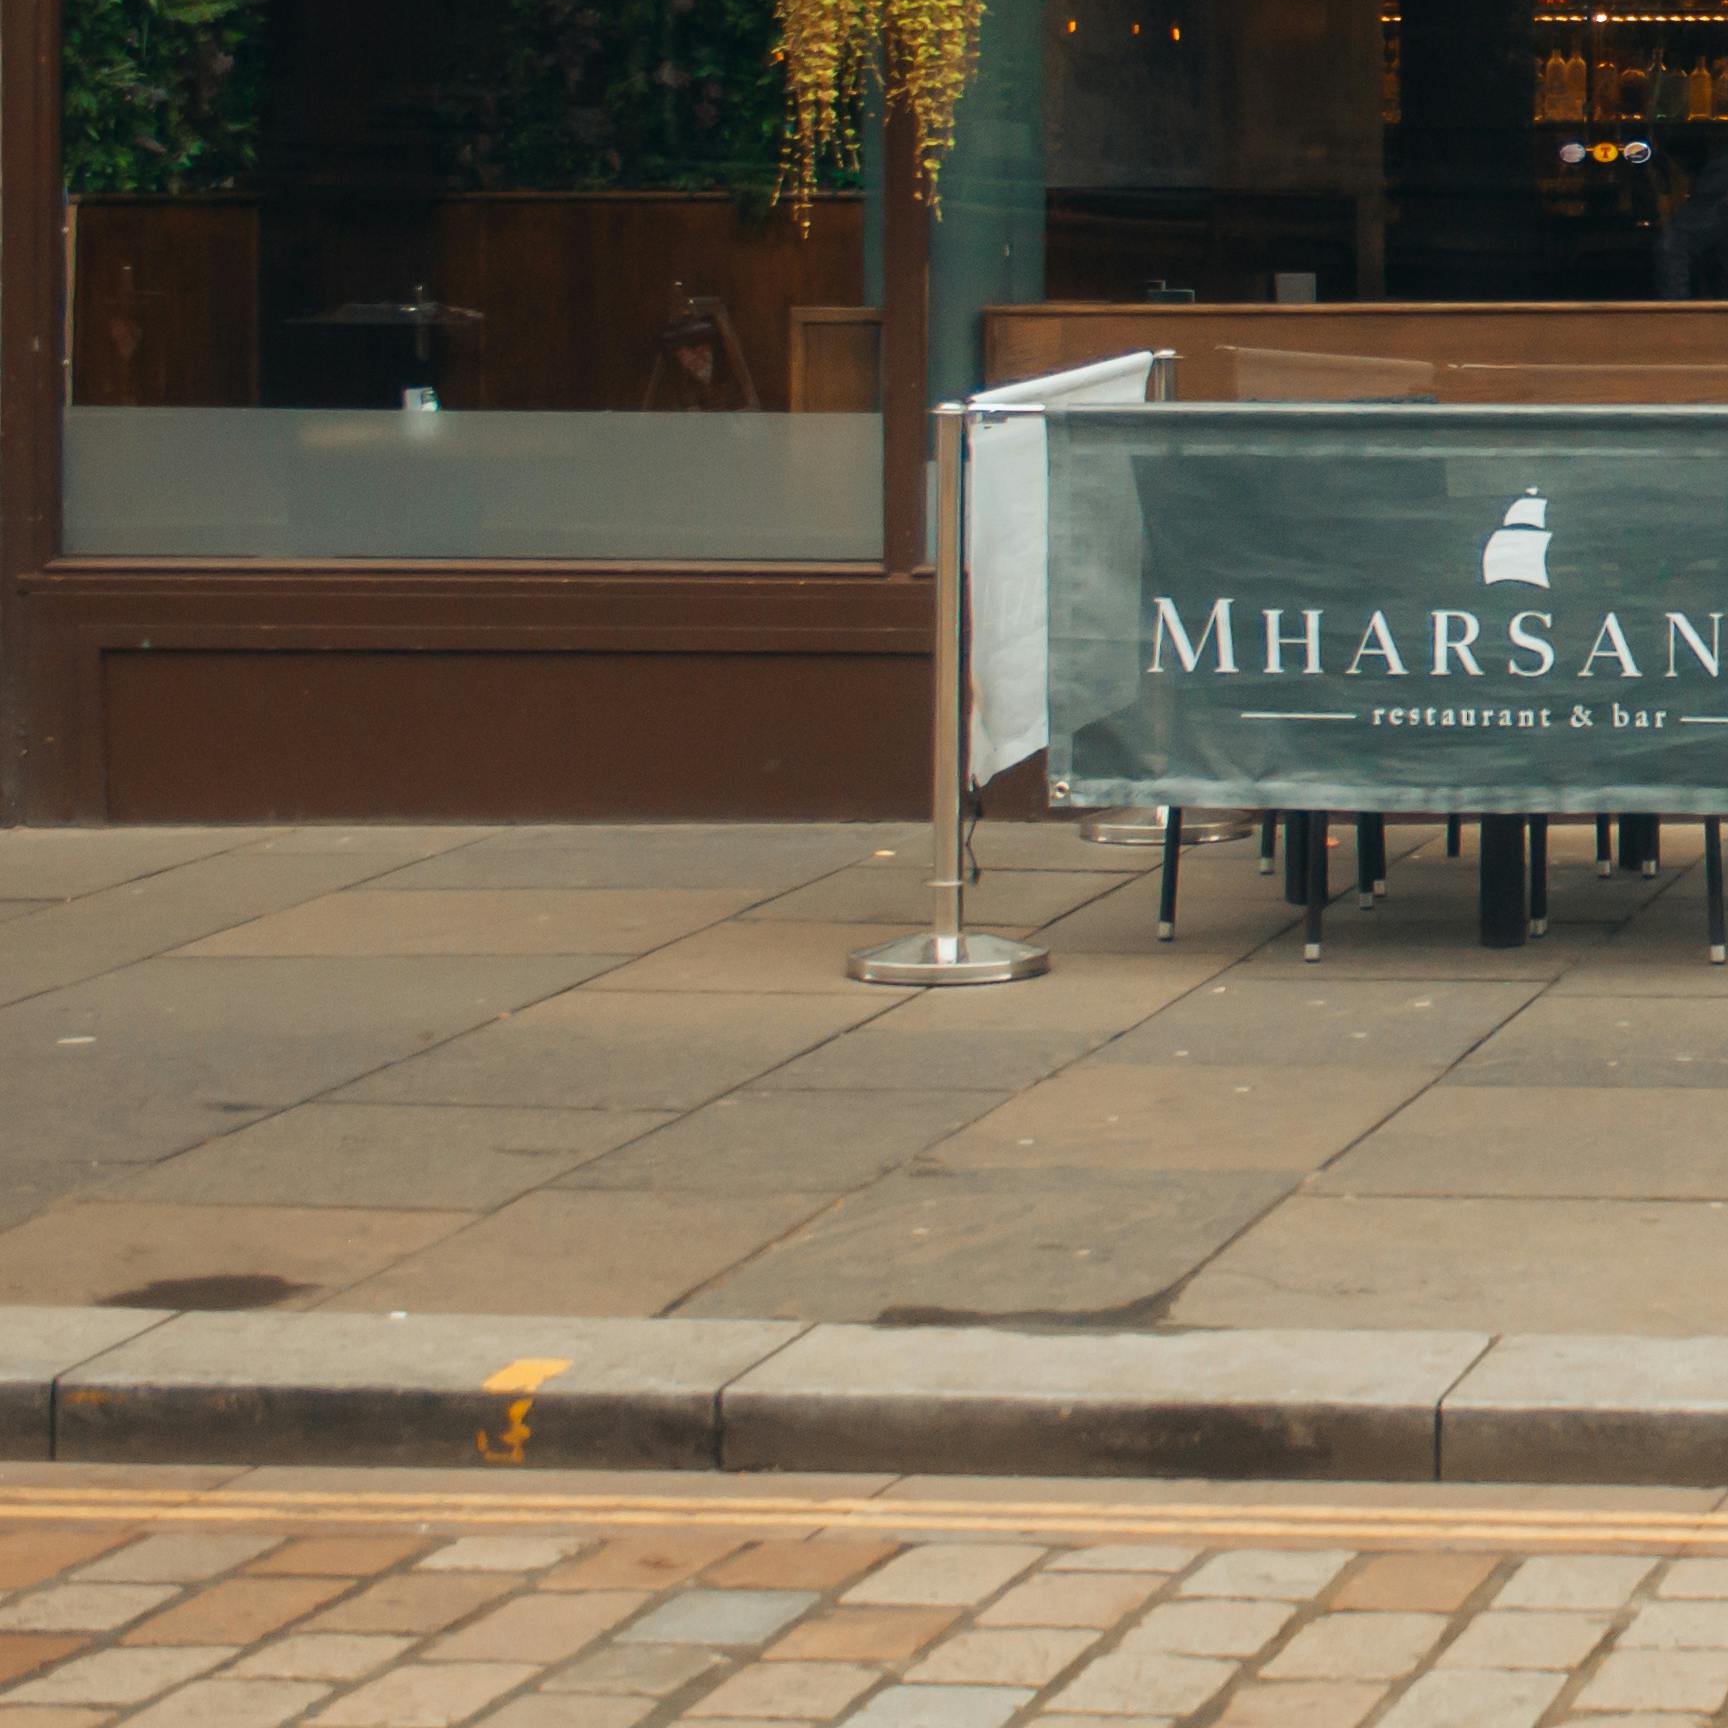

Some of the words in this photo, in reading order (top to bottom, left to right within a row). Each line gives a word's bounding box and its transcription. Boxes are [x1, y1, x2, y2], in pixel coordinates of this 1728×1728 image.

[1373, 704, 1552, 729] restaurant
[1570, 705, 1595, 729] &
[1612, 702, 1669, 729] bar
